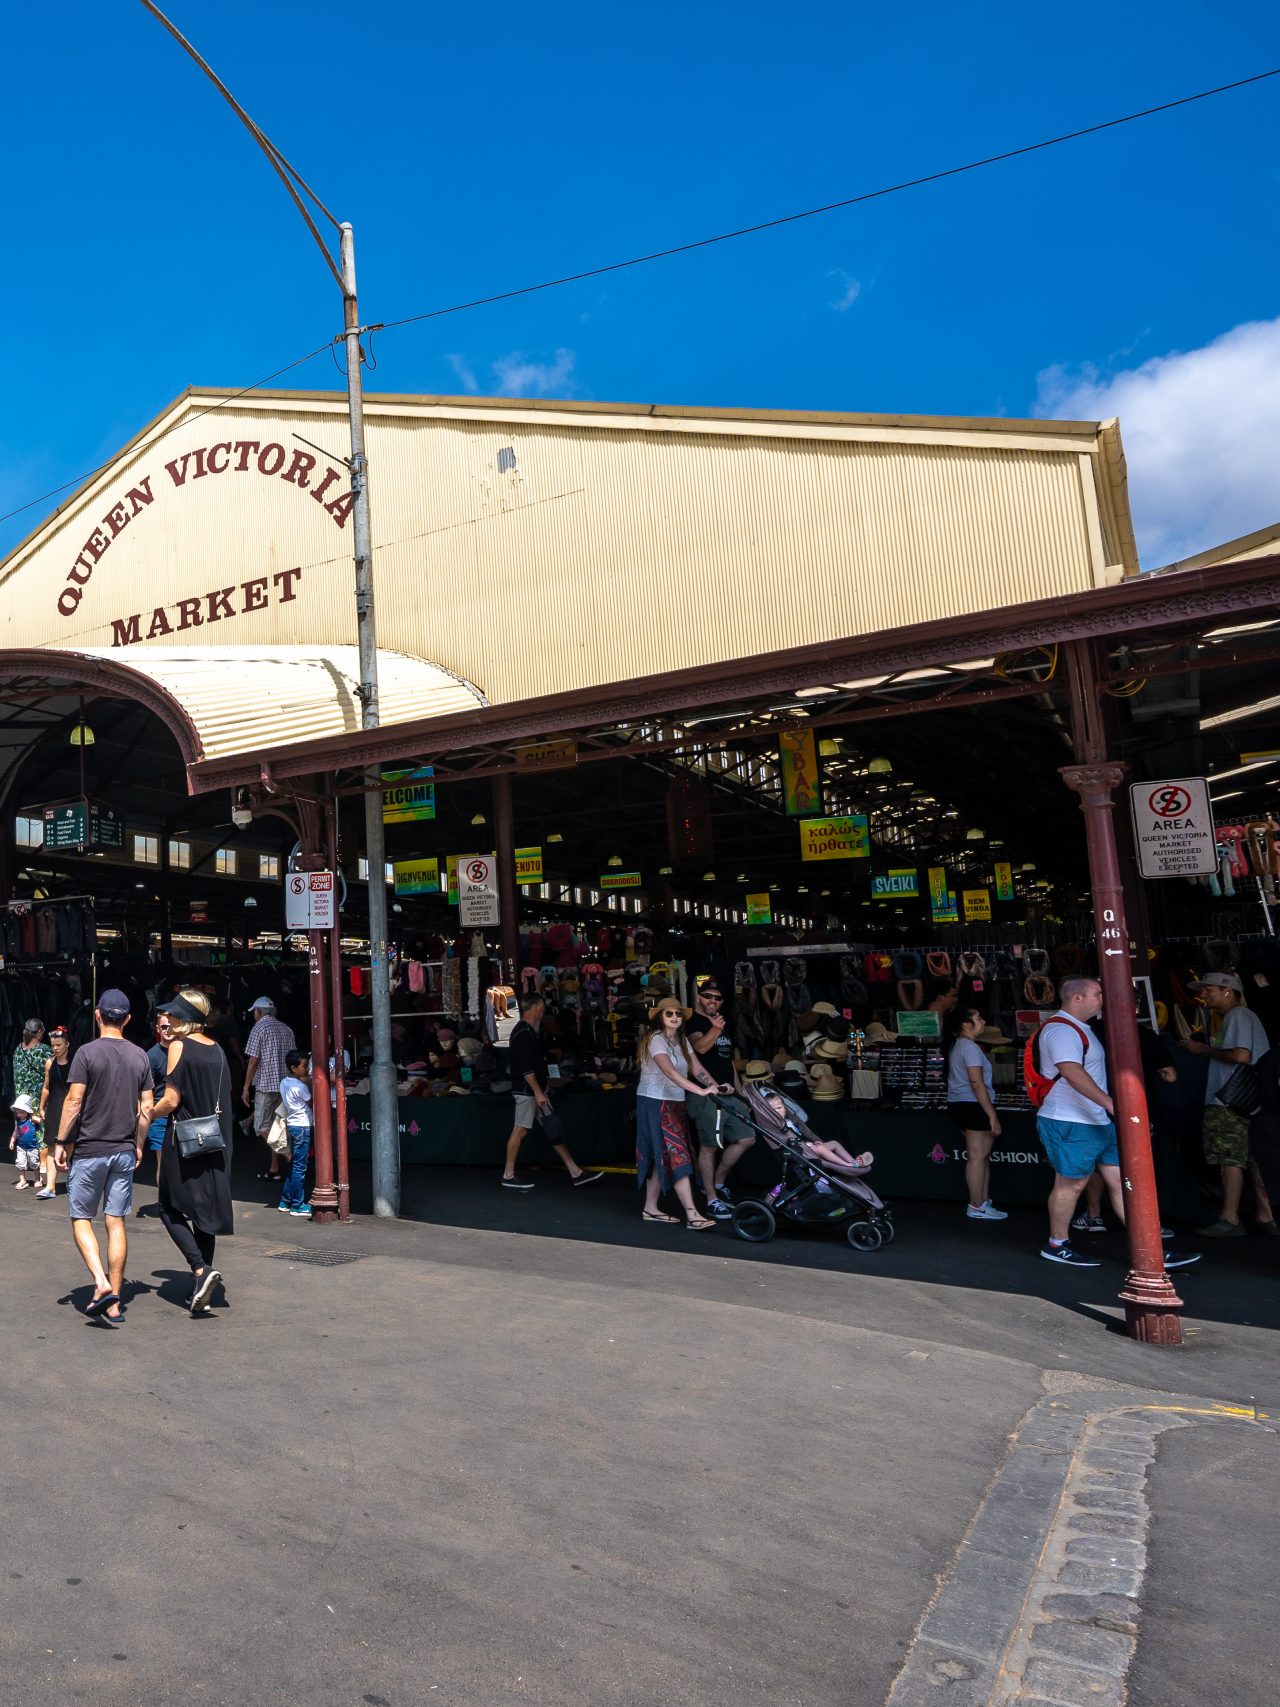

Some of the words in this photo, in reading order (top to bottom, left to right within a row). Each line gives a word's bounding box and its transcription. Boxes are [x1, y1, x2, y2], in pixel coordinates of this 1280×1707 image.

[57, 475, 156, 617] QUEEN
[164, 440, 355, 529] VICTORIA
[110, 566, 302, 647] MARKET
[792, 751, 813, 810] BAR
[382, 785, 433, 805] ELCOME
[1152, 818, 1195, 831] AREA
[1142, 834, 1168, 842] QUEEN
[1171, 832, 1208, 840] VICTORIA
[1159, 840, 1192, 848] MARKET
[1152, 848, 1202, 856] AUTHORISED
[515, 859, 541, 873] ENUTO
[1158, 855, 1197, 864] VEHICLES
[1158, 863, 1199, 872] EXCEPTED
[311, 875, 331, 883] PERMIT
[395, 869, 437, 884] BIENVENUE
[311, 882, 331, 890] ZONE
[467, 884, 489, 893] AREA
[875, 875, 914, 892] SVEIKI
[1103, 909, 1115, 922] Q
[1101, 927, 1121, 939] 46
[989, 1151, 1039, 1164] ASHION
